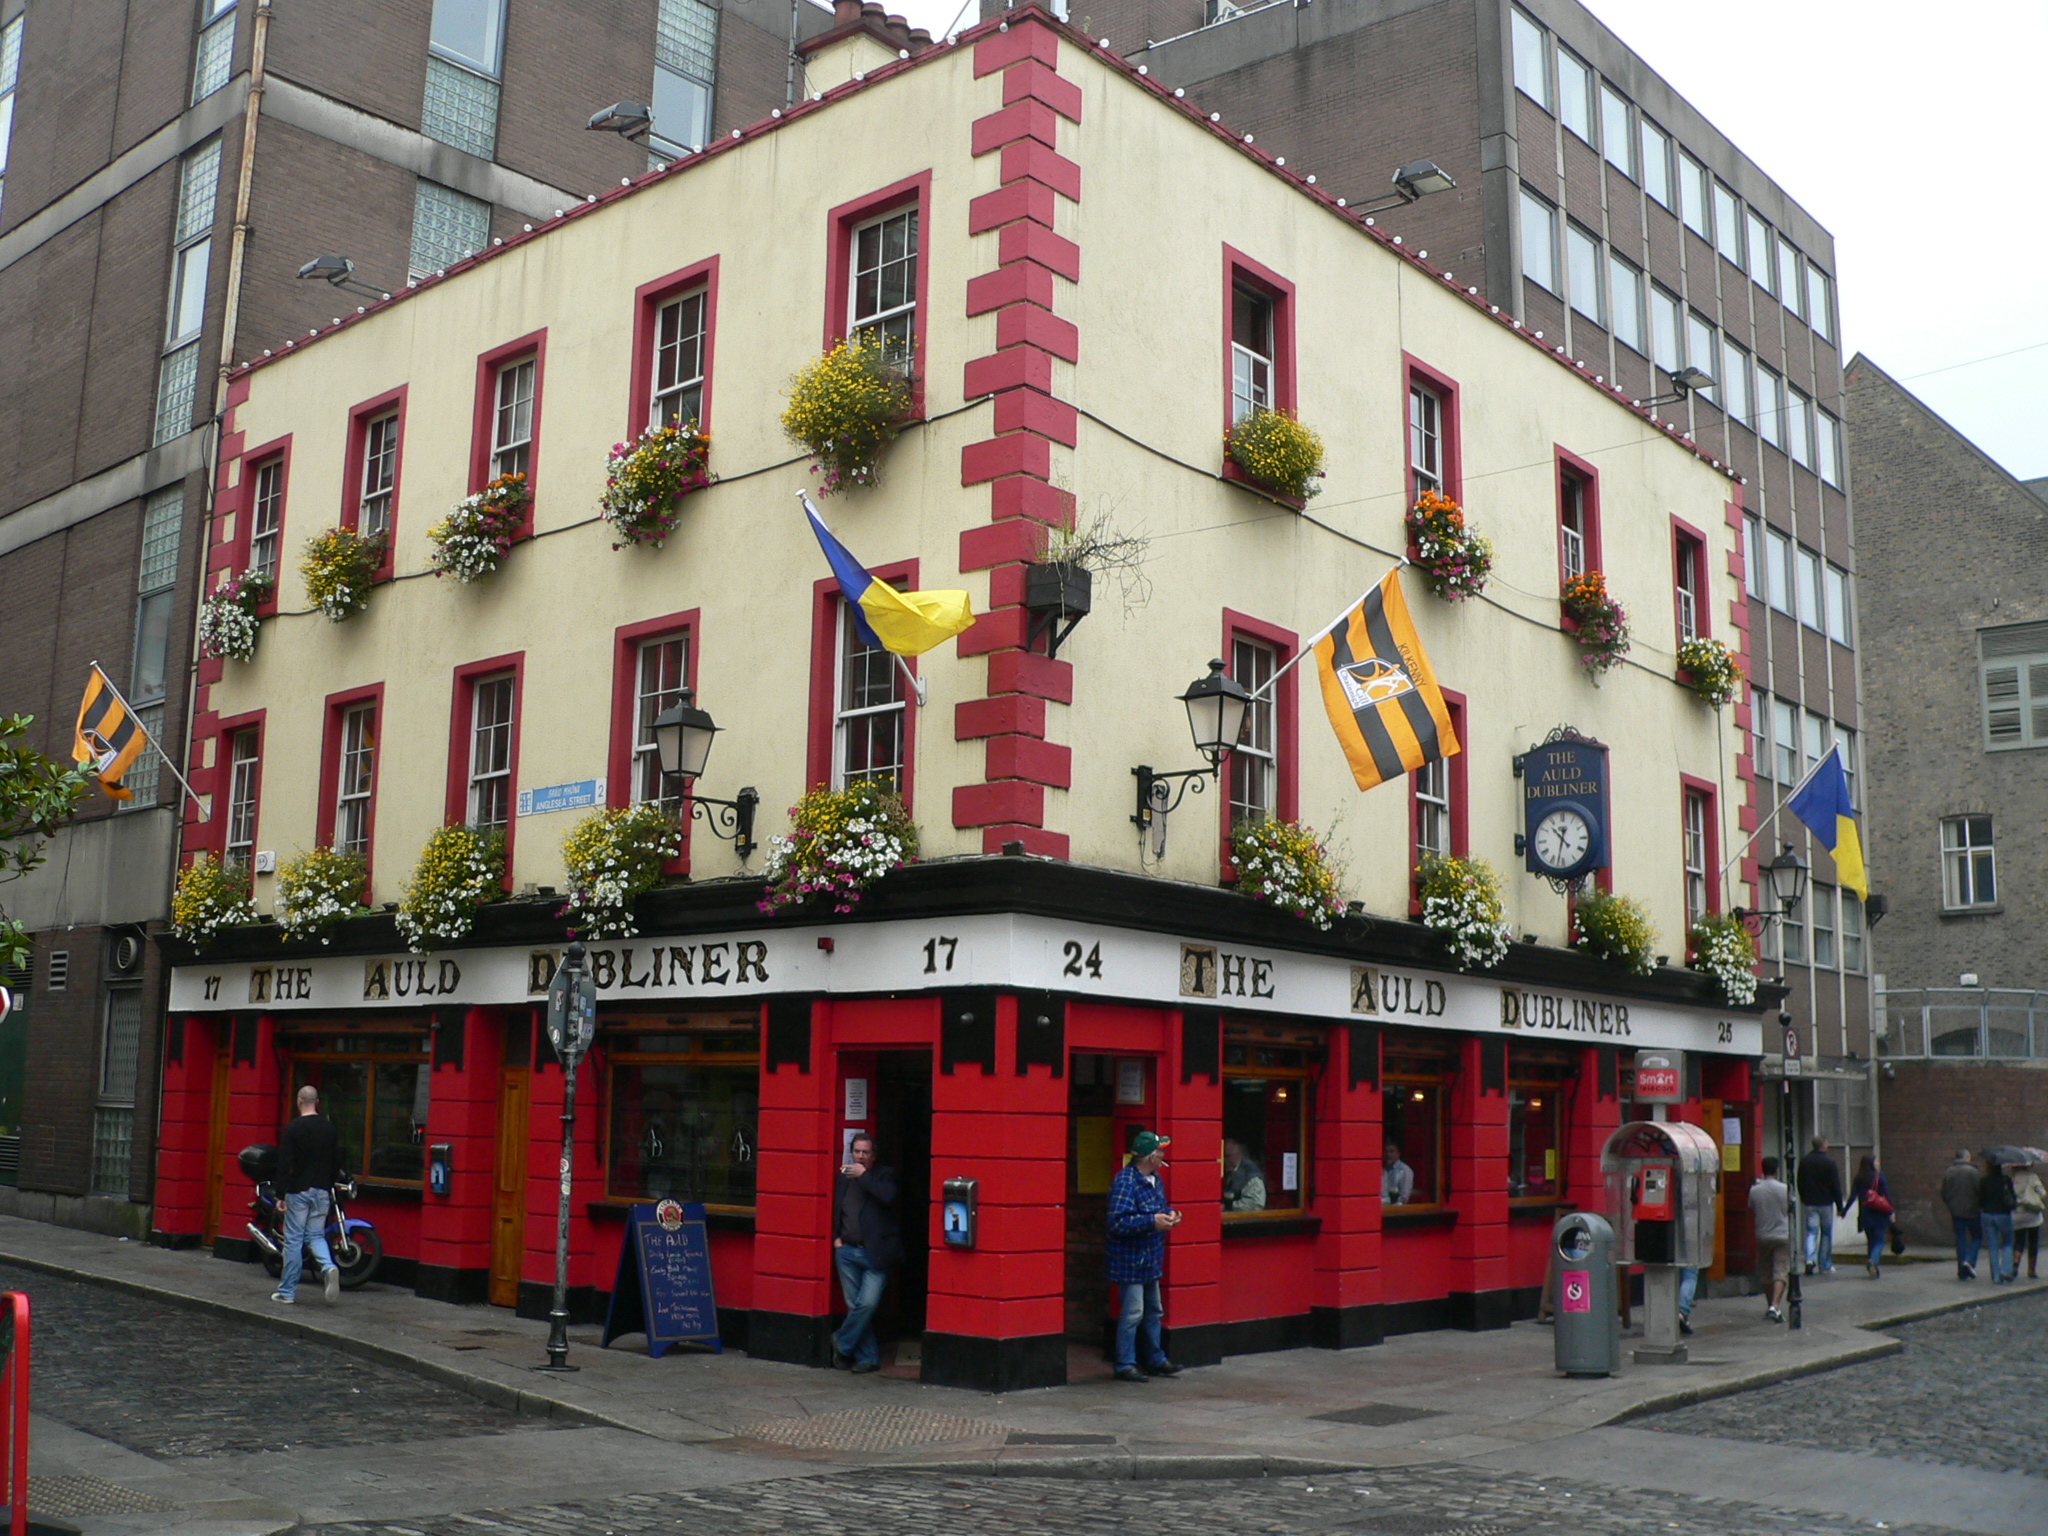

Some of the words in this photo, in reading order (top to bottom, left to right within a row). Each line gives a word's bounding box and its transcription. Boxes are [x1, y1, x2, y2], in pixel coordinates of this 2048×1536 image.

[1398, 643, 1426, 686] KILKENNY
[1547, 751, 1576, 765] THE
[1542, 767, 1582, 782] AULD
[597, 784, 604, 798] 2
[1527, 781, 1598, 799] DUBLINER
[535, 798, 567, 811] ANGLESEA
[568, 794, 592, 806] STREET
[204, 975, 222, 1001] 17
[251, 966, 313, 1001] THE
[364, 958, 462, 997] AULD
[531, 940, 770, 993] DBLINER
[923, 935, 959, 975] 17
[1063, 940, 1103, 980] 24
[1183, 948, 1275, 1000] THE
[1352, 970, 1447, 1017] AULD
[1502, 988, 1632, 1037] DUBLINER
[1717, 1021, 1733, 1044] 25
[1640, 1073, 1674, 1085] Smart
